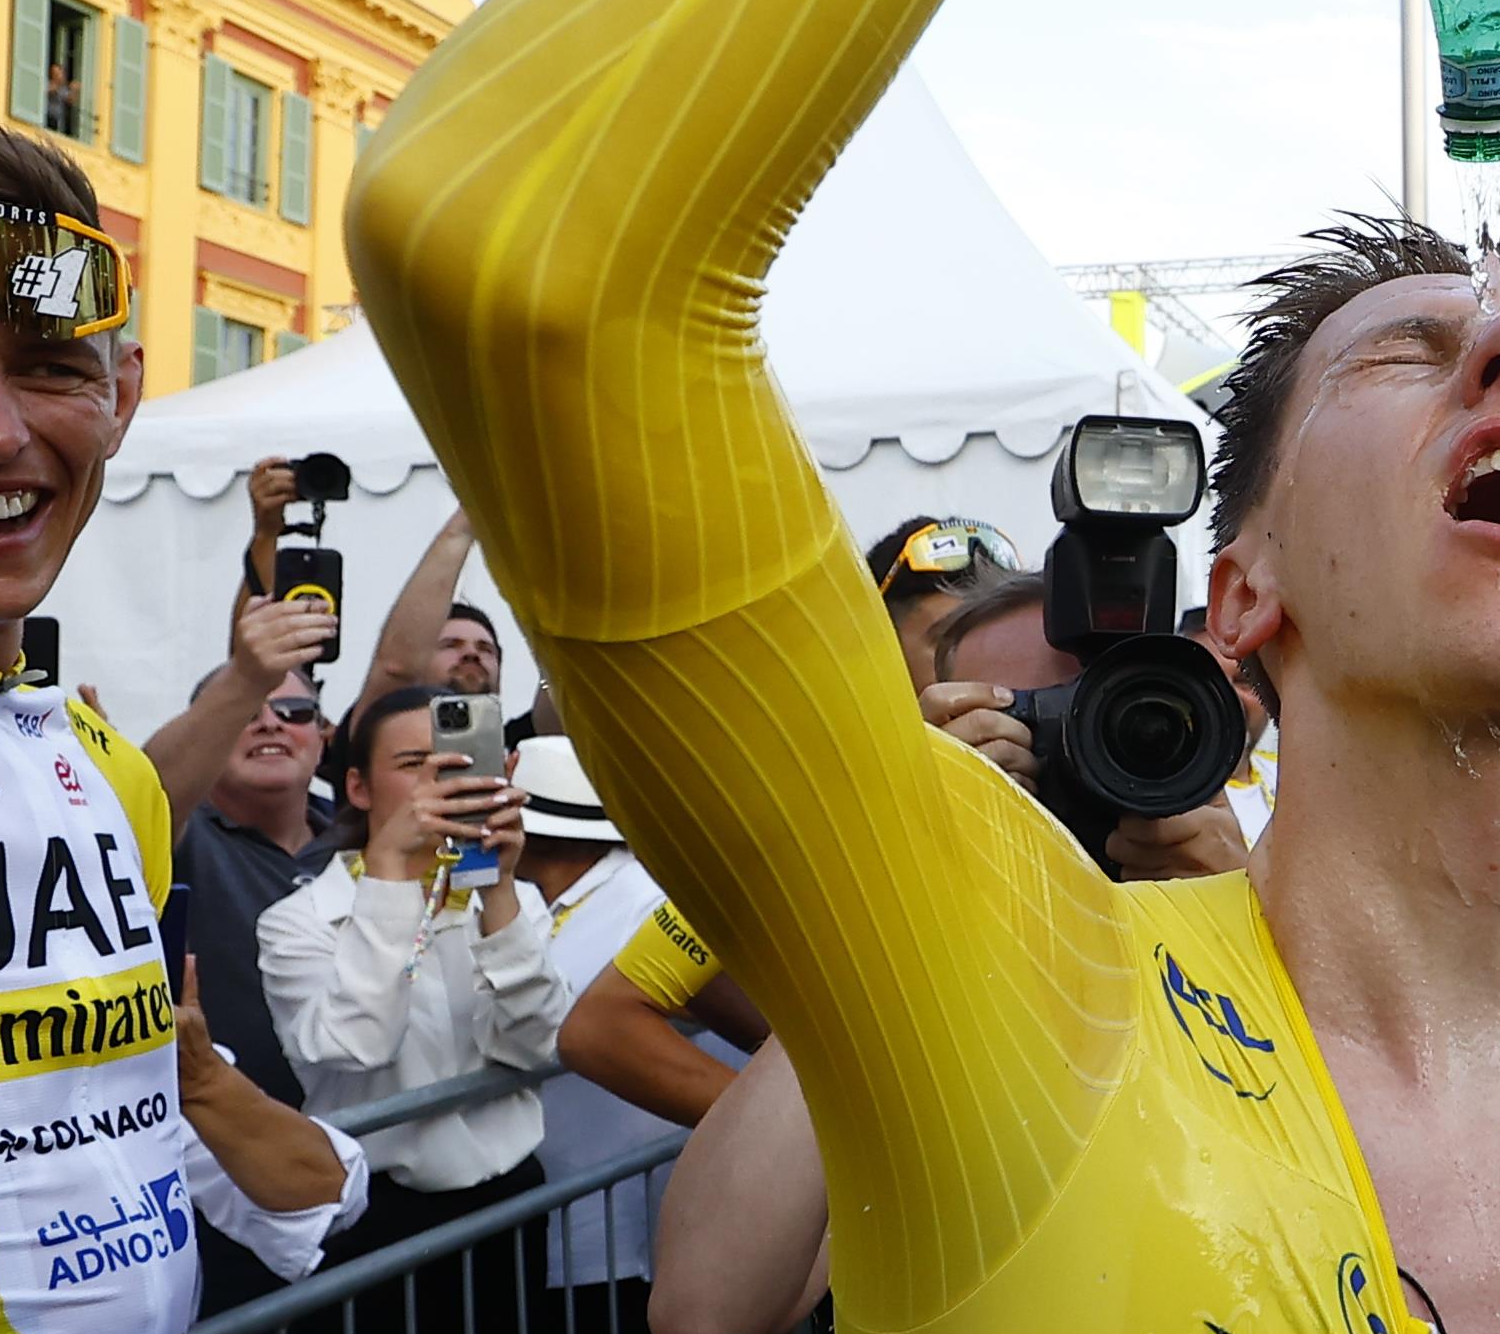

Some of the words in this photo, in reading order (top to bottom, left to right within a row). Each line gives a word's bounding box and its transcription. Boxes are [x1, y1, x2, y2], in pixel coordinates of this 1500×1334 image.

[11, 248, 91, 319] #1
[653, 903, 710, 966] mirates
[33, 1092, 168, 1154] COLNAGO
[48, 1228, 170, 1290] ADNOC
